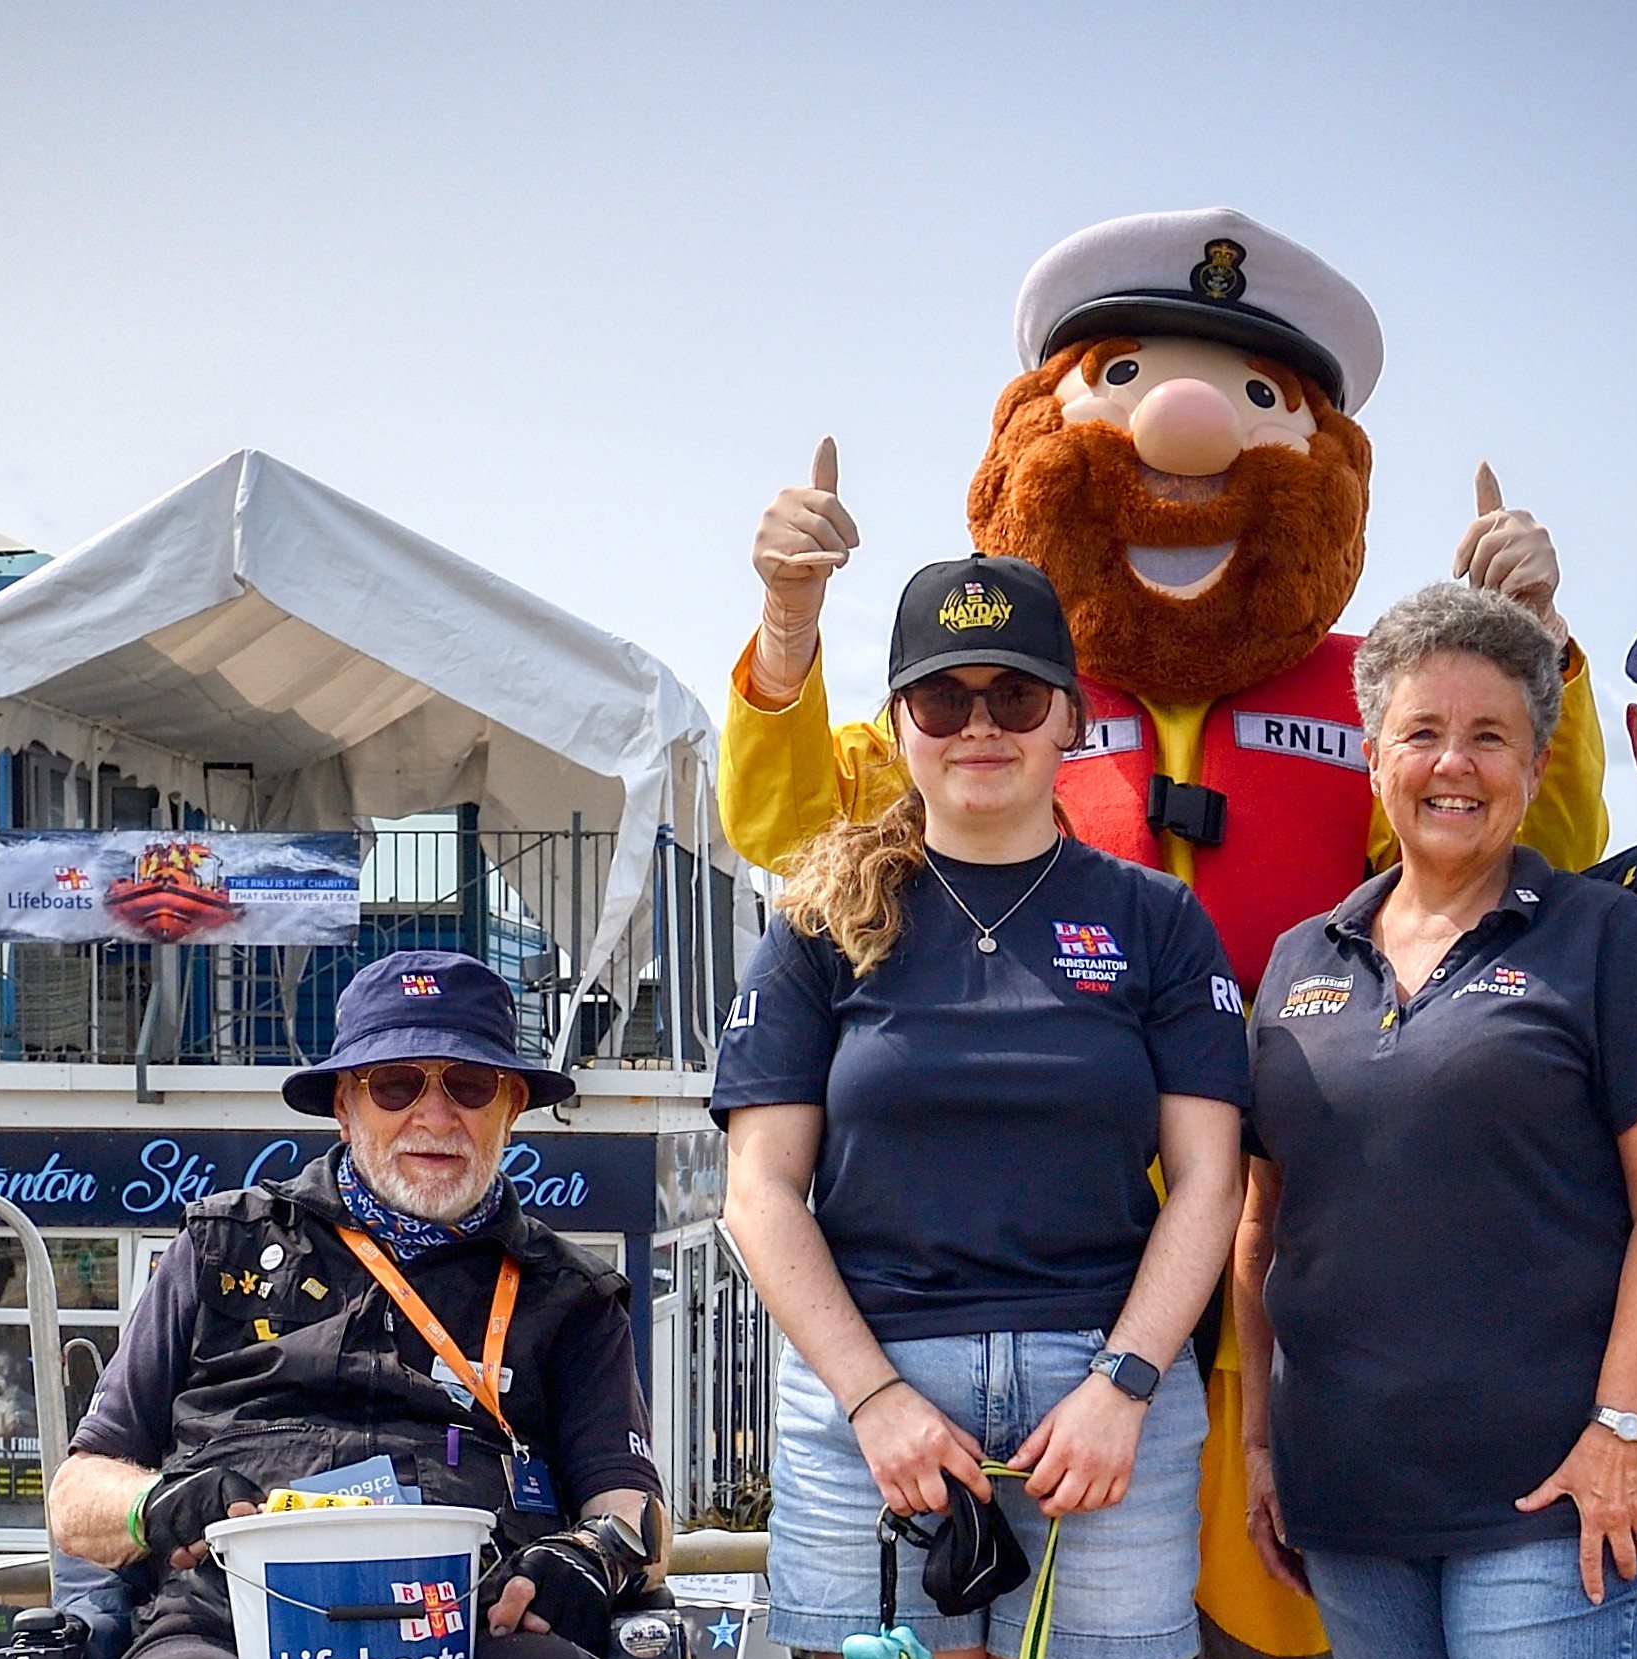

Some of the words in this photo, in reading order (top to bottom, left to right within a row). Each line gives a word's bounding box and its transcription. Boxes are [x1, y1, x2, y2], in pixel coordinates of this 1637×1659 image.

[939, 603, 1013, 625] MAYDAY
[1264, 719, 1346, 759] RNLI
[230, 878, 248, 888] THE
[251, 878, 273, 888] RNLI
[275, 879, 284, 888] IS
[287, 879, 305, 888] THE
[308, 880, 349, 888] CHARITY
[8, 892, 92, 910] Lifeboats
[234, 892, 258, 901] THAT
[261, 892, 290, 901] SAVES
[293, 892, 320, 901] LIVES
[322, 893, 334, 901] AT
[1053, 957, 1128, 971] HUNSTANTON
[1066, 968, 1117, 981] LIFEBOAT
[1075, 980, 1110, 992] CREW
[1293, 977, 1350, 994] FUNDRAISING
[1211, 975, 1246, 1017] RN
[1286, 989, 1350, 1007] VOLUNTEER
[723, 990, 758, 1030] LI
[1279, 1000, 1346, 1018] CREW
[498, 1143, 589, 1207] Bar
